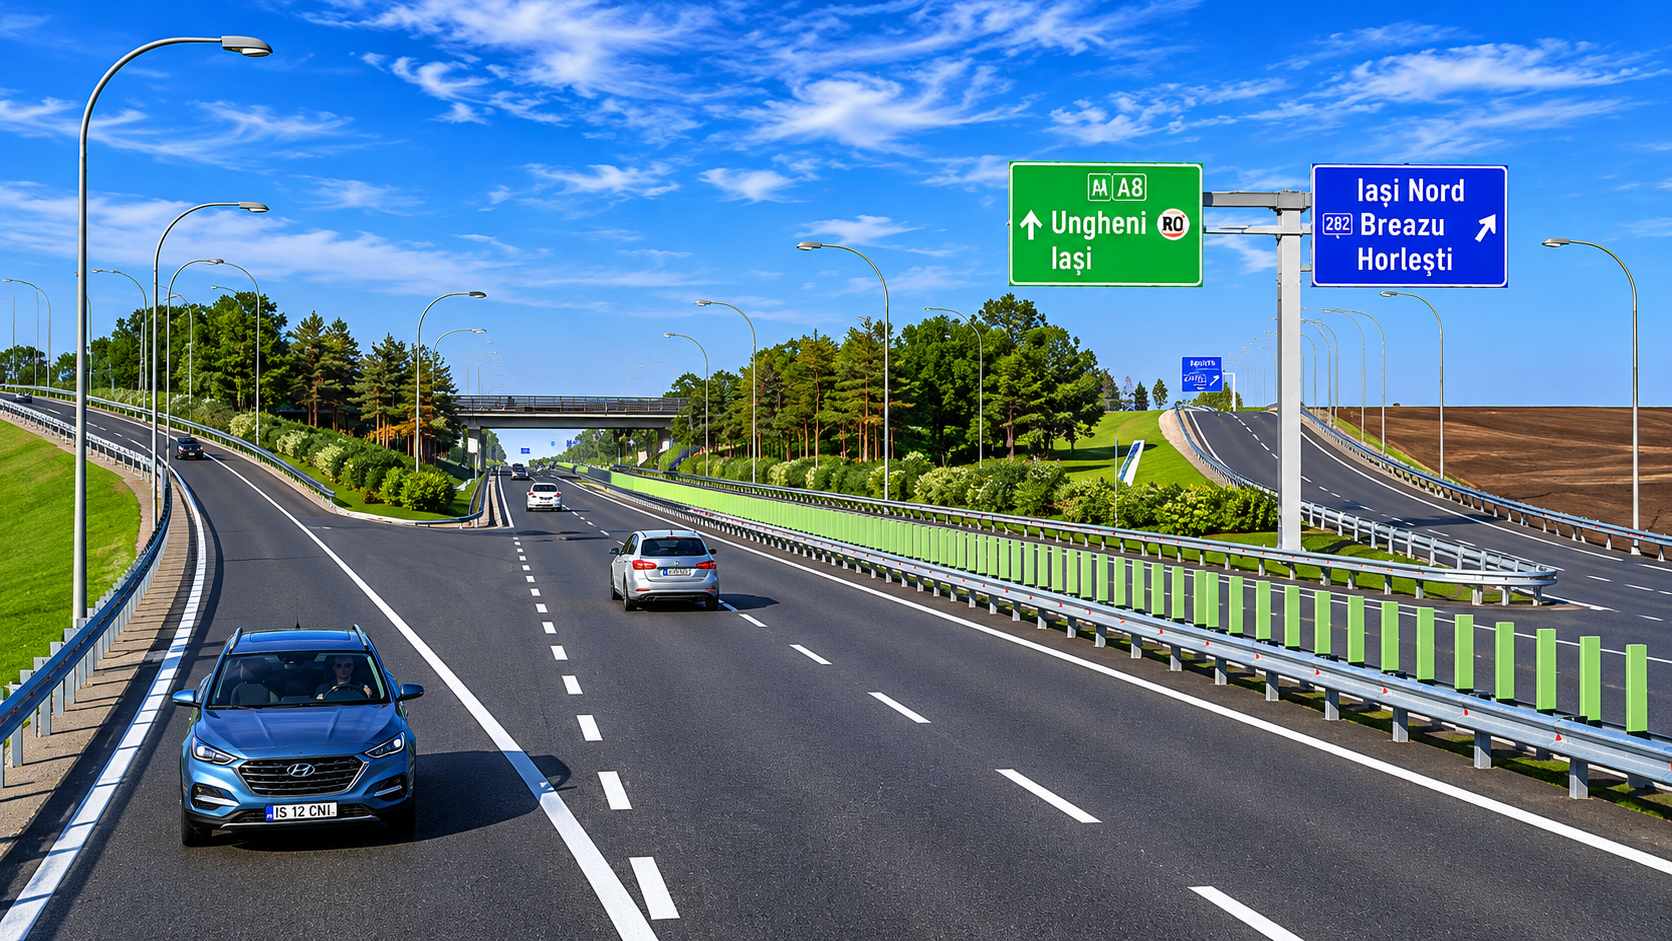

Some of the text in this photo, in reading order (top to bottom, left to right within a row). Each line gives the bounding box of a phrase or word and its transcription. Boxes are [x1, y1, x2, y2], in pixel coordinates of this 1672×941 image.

[1117, 177, 1143, 197] A8
[1408, 178, 1465, 202] Nord
[1052, 210, 1147, 240] Ungheni
[1162, 216, 1184, 232] RO
[1325, 216, 1351, 231] 282
[1360, 212, 1445, 236] Breazu
[275, 804, 331, 819] IS 12 CNI
